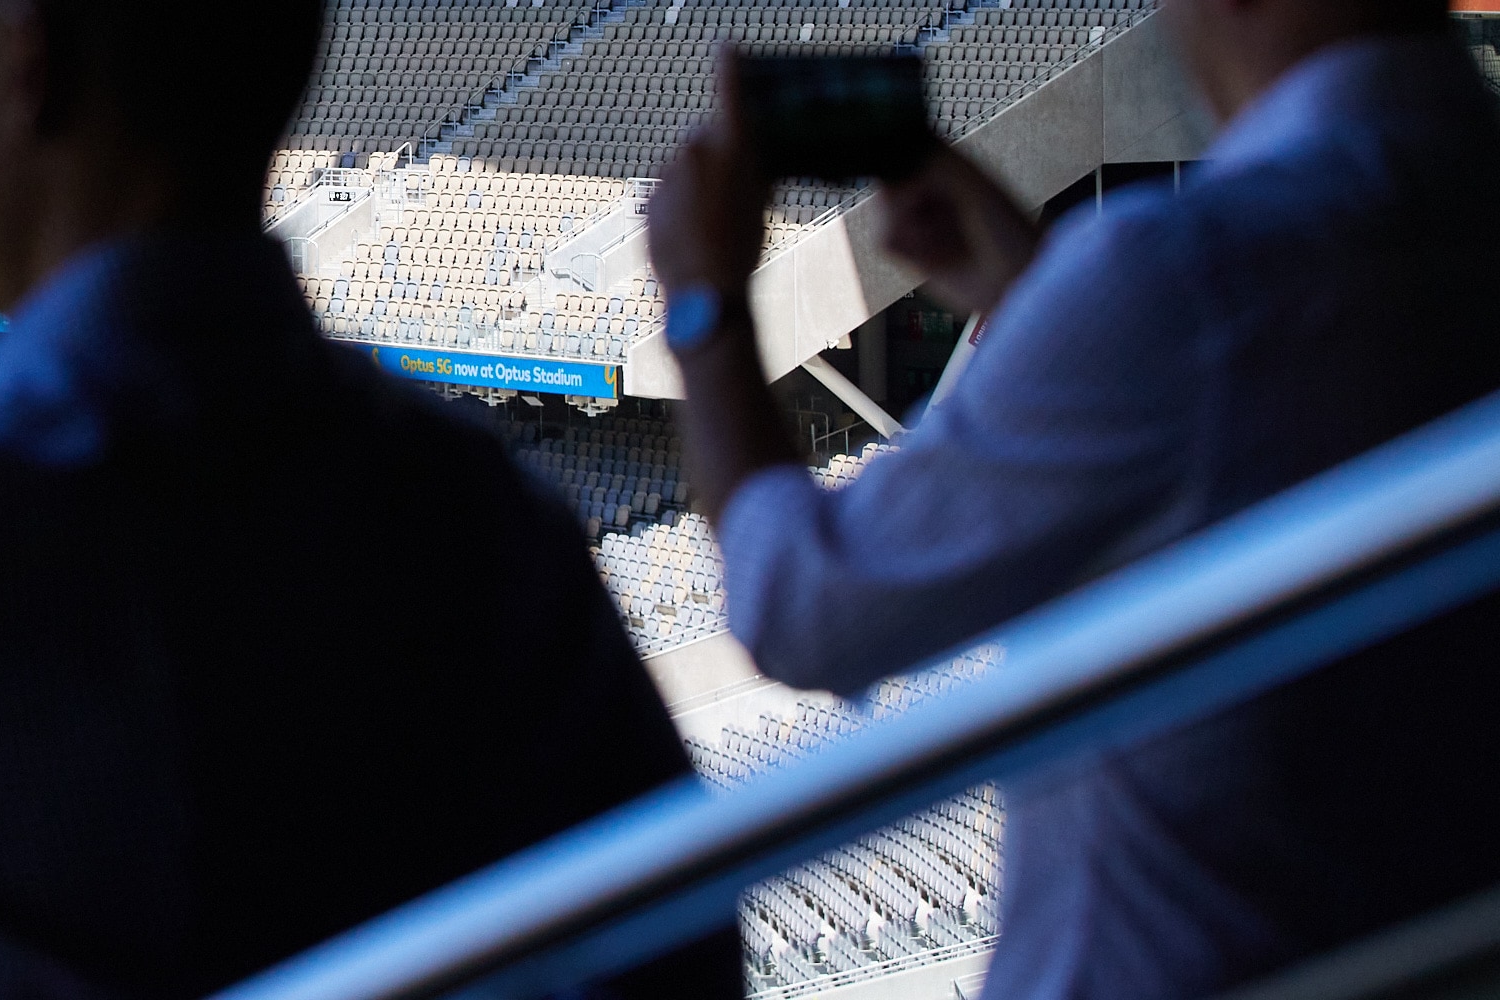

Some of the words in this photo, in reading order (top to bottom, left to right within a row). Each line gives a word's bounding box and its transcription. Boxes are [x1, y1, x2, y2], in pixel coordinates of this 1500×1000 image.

[401, 354, 435, 374] Optus
[436, 357, 453, 375] 5G
[454, 363, 479, 378] now
[480, 362, 494, 379] at
[495, 363, 531, 384] Optus
[533, 365, 582, 387] Stadium
